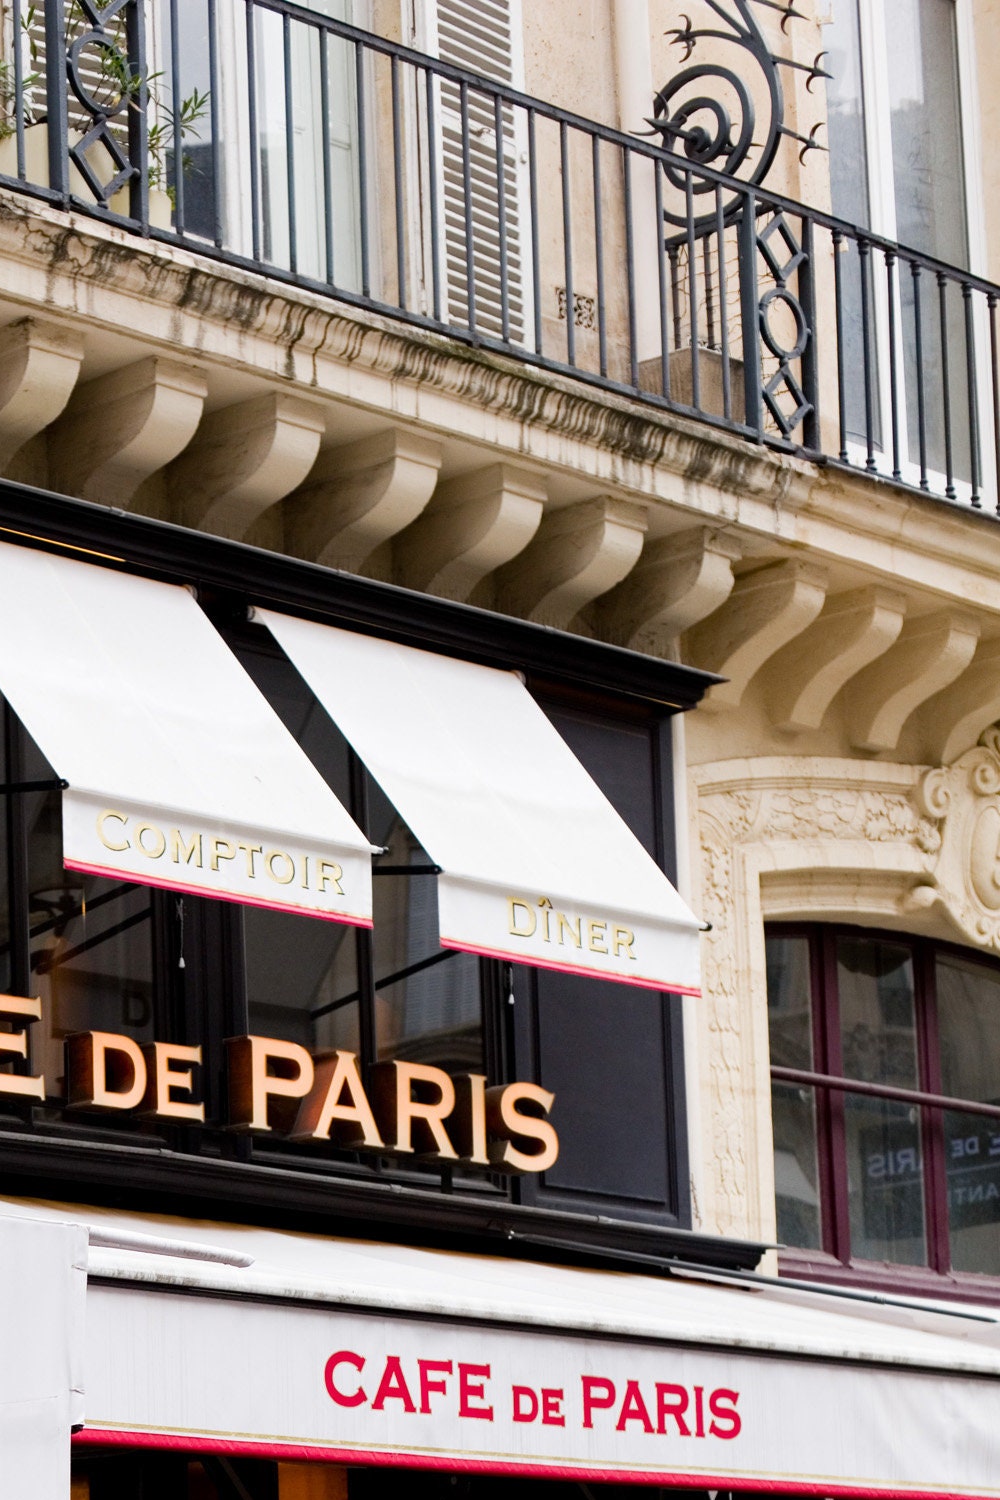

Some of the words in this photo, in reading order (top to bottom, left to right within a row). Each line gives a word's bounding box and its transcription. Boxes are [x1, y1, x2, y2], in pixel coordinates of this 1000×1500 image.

[96, 808, 346, 897] COMPTOIR
[507, 896, 637, 959] DÎNER
[86, 1031, 205, 1123] DE
[246, 1035, 559, 1174] PARIS
[324, 1350, 494, 1422] CAFE
[512, 1385, 566, 1427] DE
[581, 1375, 742, 1440] PARIS
